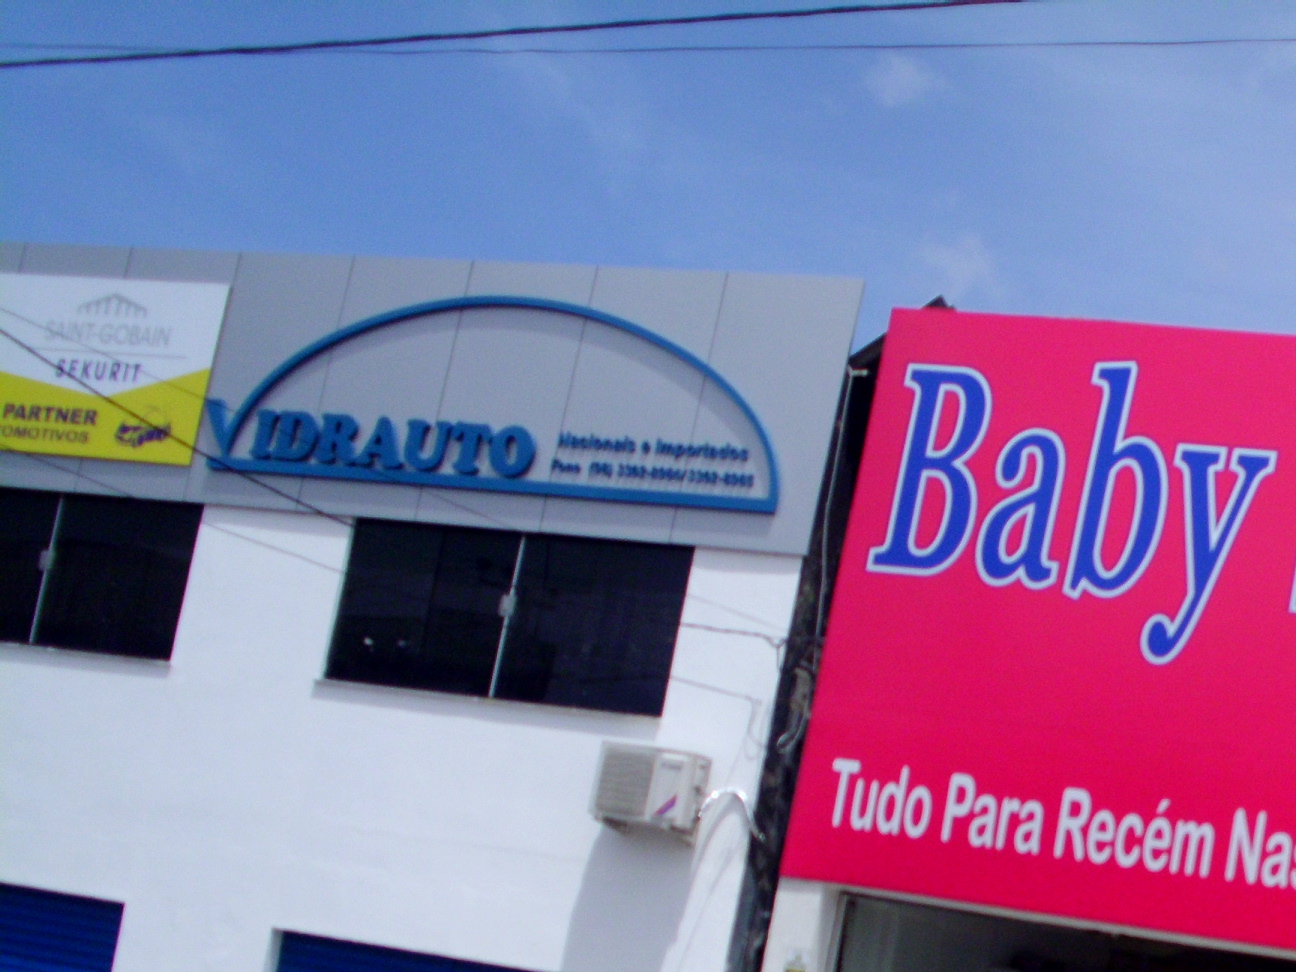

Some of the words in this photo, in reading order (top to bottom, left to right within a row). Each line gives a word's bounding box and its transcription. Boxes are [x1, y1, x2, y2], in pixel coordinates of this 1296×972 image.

[44, 320, 174, 347] SAINT-GOBAIN
[54, 358, 143, 383] SEKURIT
[3, 403, 98, 426] PARTNER
[0, 424, 89, 444] OMOTIVOS
[205, 397, 537, 481] VIDRAUTO
[866, 361, 1277, 665] Baby
[832, 757, 932, 839] Tudo
[940, 772, 1044, 855] Para
[1053, 786, 1215, 878] Recém
